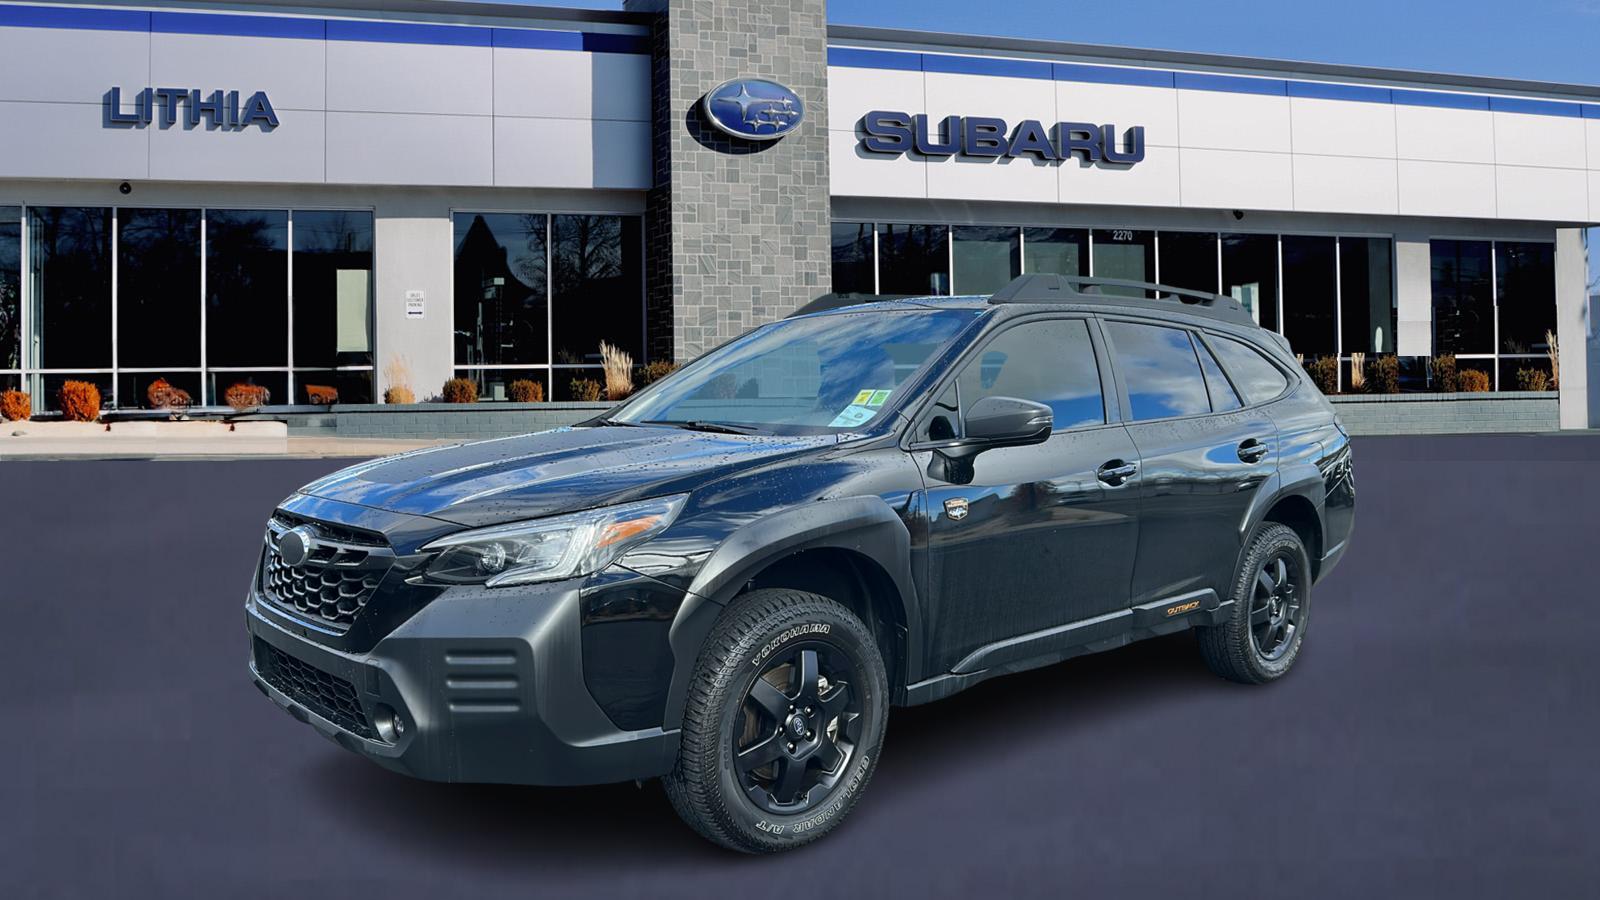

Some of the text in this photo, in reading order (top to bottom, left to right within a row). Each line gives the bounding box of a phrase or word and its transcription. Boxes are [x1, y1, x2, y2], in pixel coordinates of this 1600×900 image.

[109, 86, 280, 128] LITHIA
[857, 110, 1146, 164] SUBARU
[1112, 230, 1133, 241] 2270
[1167, 600, 1200, 616] OUTBACK
[752, 623, 831, 667] YOKOHAMA
[755, 755, 870, 835] GEOLANDAR A/T
